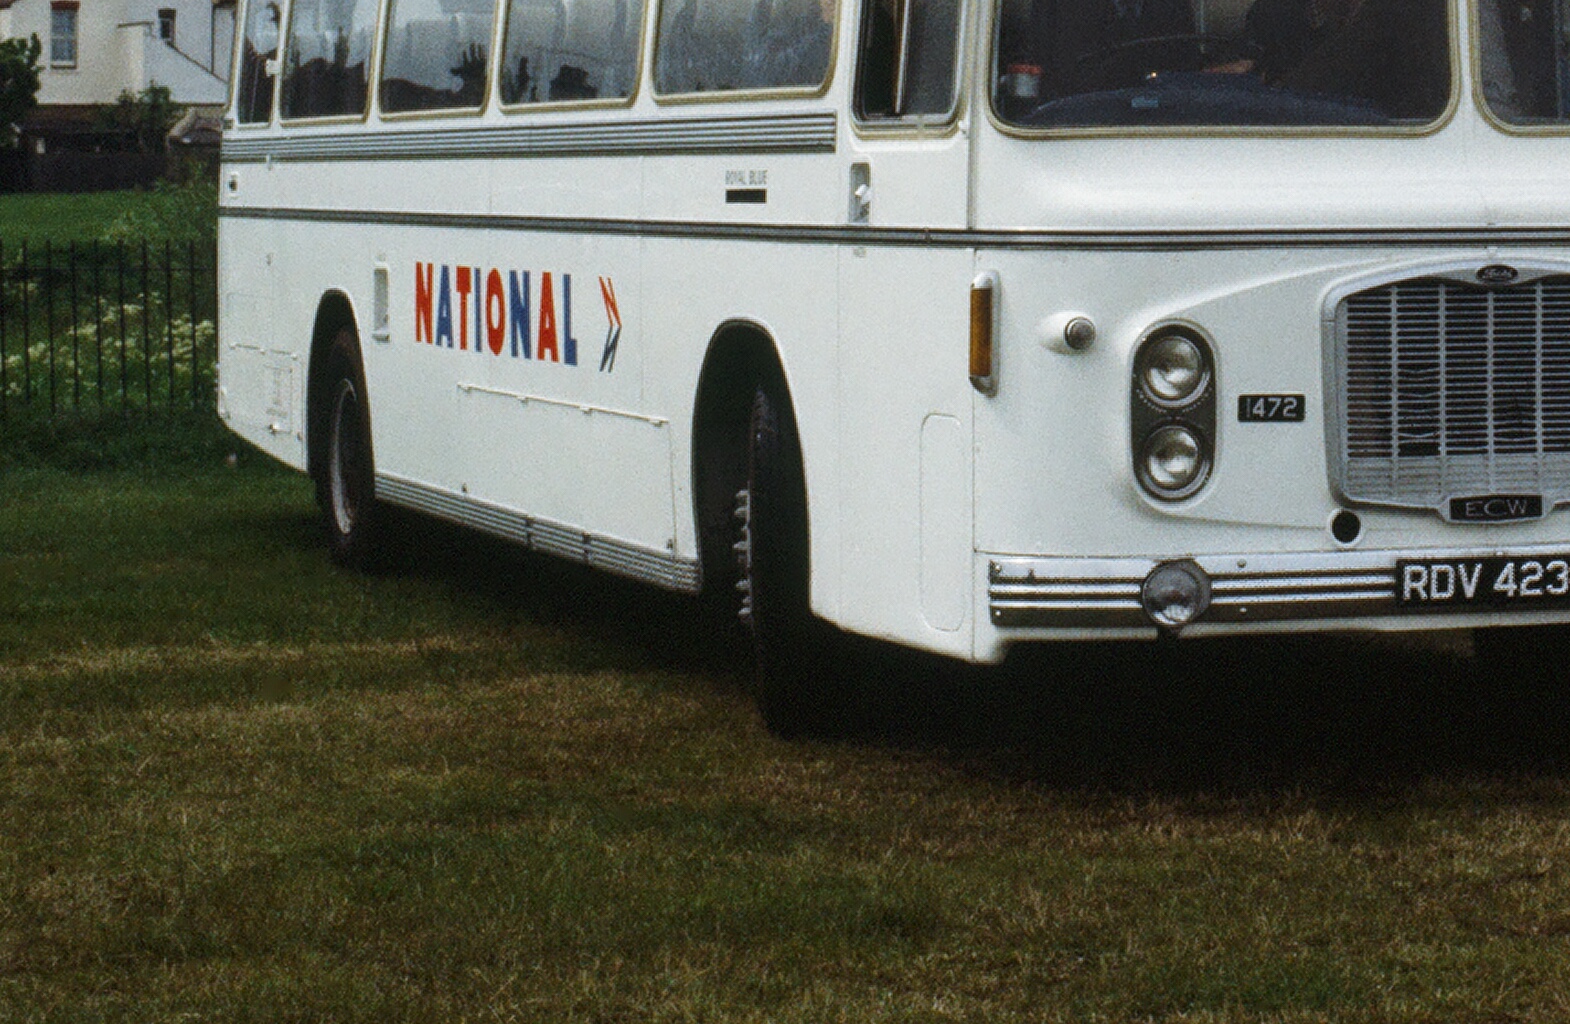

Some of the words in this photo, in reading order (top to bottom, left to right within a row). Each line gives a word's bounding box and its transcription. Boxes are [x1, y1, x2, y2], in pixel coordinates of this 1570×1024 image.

[414, 260, 578, 367] NATIONAL
[1245, 396, 1298, 418] 1472
[1464, 498, 1529, 518] ECW
[1402, 562, 1483, 601] RDV
